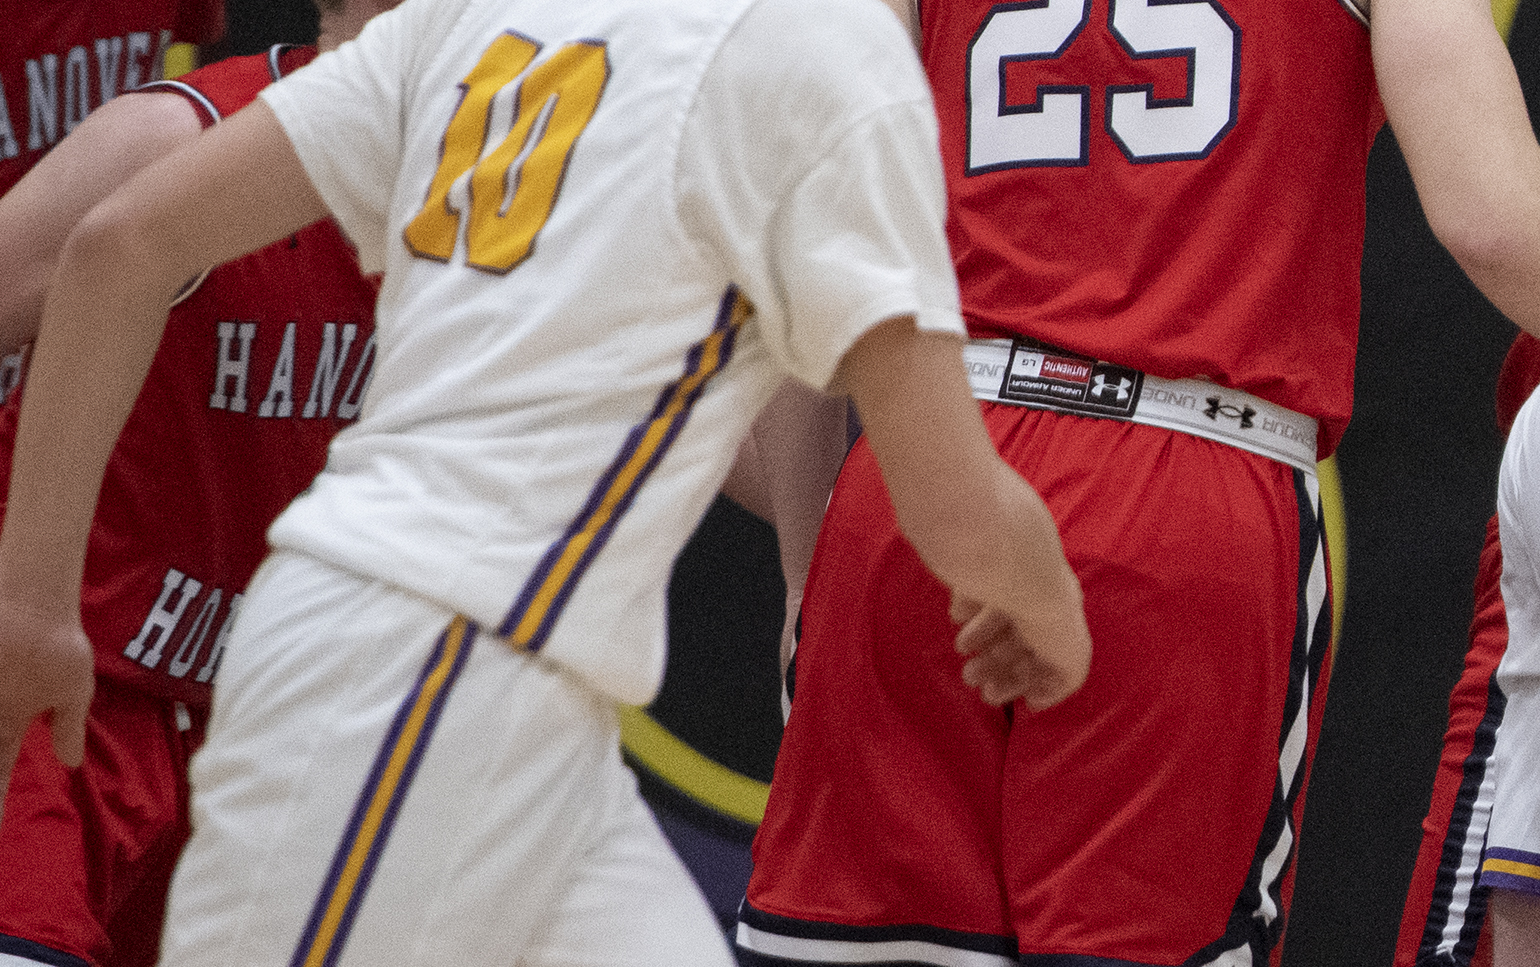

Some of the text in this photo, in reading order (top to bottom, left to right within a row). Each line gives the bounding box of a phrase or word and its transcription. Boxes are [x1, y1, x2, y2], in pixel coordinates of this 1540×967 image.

[402, 28, 612, 277] 10
[1044, 360, 1089, 377] AUTHENTIC
[1012, 379, 1082, 396] UNDER ARMOUR
